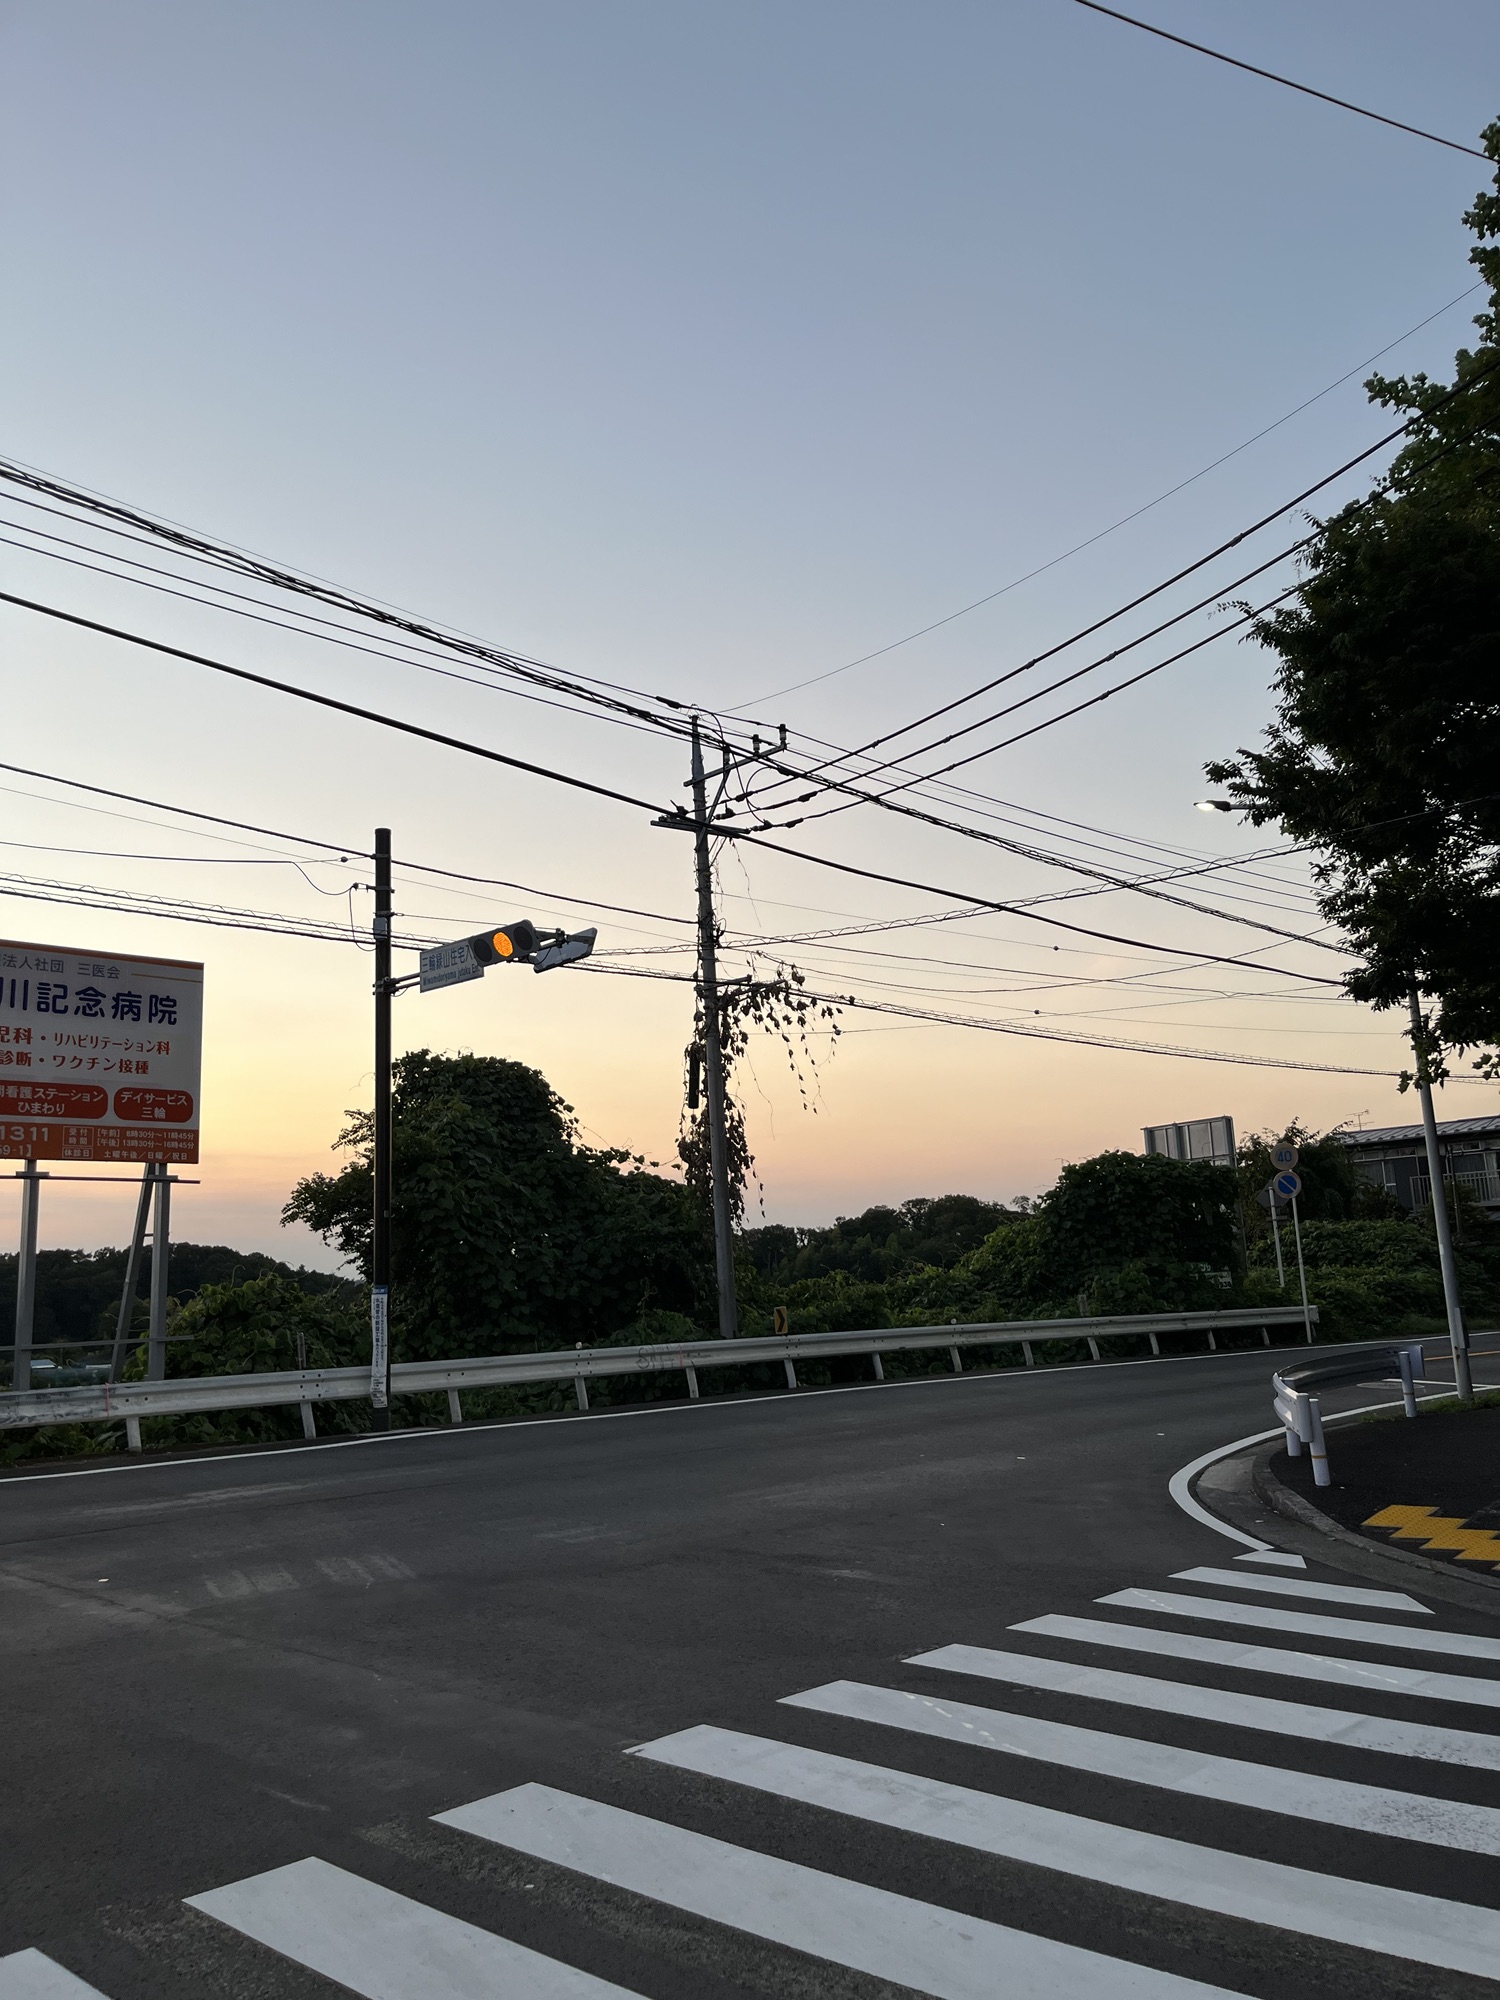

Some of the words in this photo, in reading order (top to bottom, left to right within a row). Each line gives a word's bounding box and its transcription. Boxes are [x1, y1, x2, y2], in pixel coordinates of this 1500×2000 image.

[0, 953, 64, 973] 法人社団
[77, 962, 120, 979] 三医会
[421, 944, 473, 974] 三輪緑山住宅入
[0, 976, 177, 1025] 川記念病院
[120, 1091, 187, 1106] デイサービス
[18, 1101, 65, 1115] ひまわり
[141, 1107, 166, 1119] 三輪
[1277, 1150, 1292, 1162] 40
